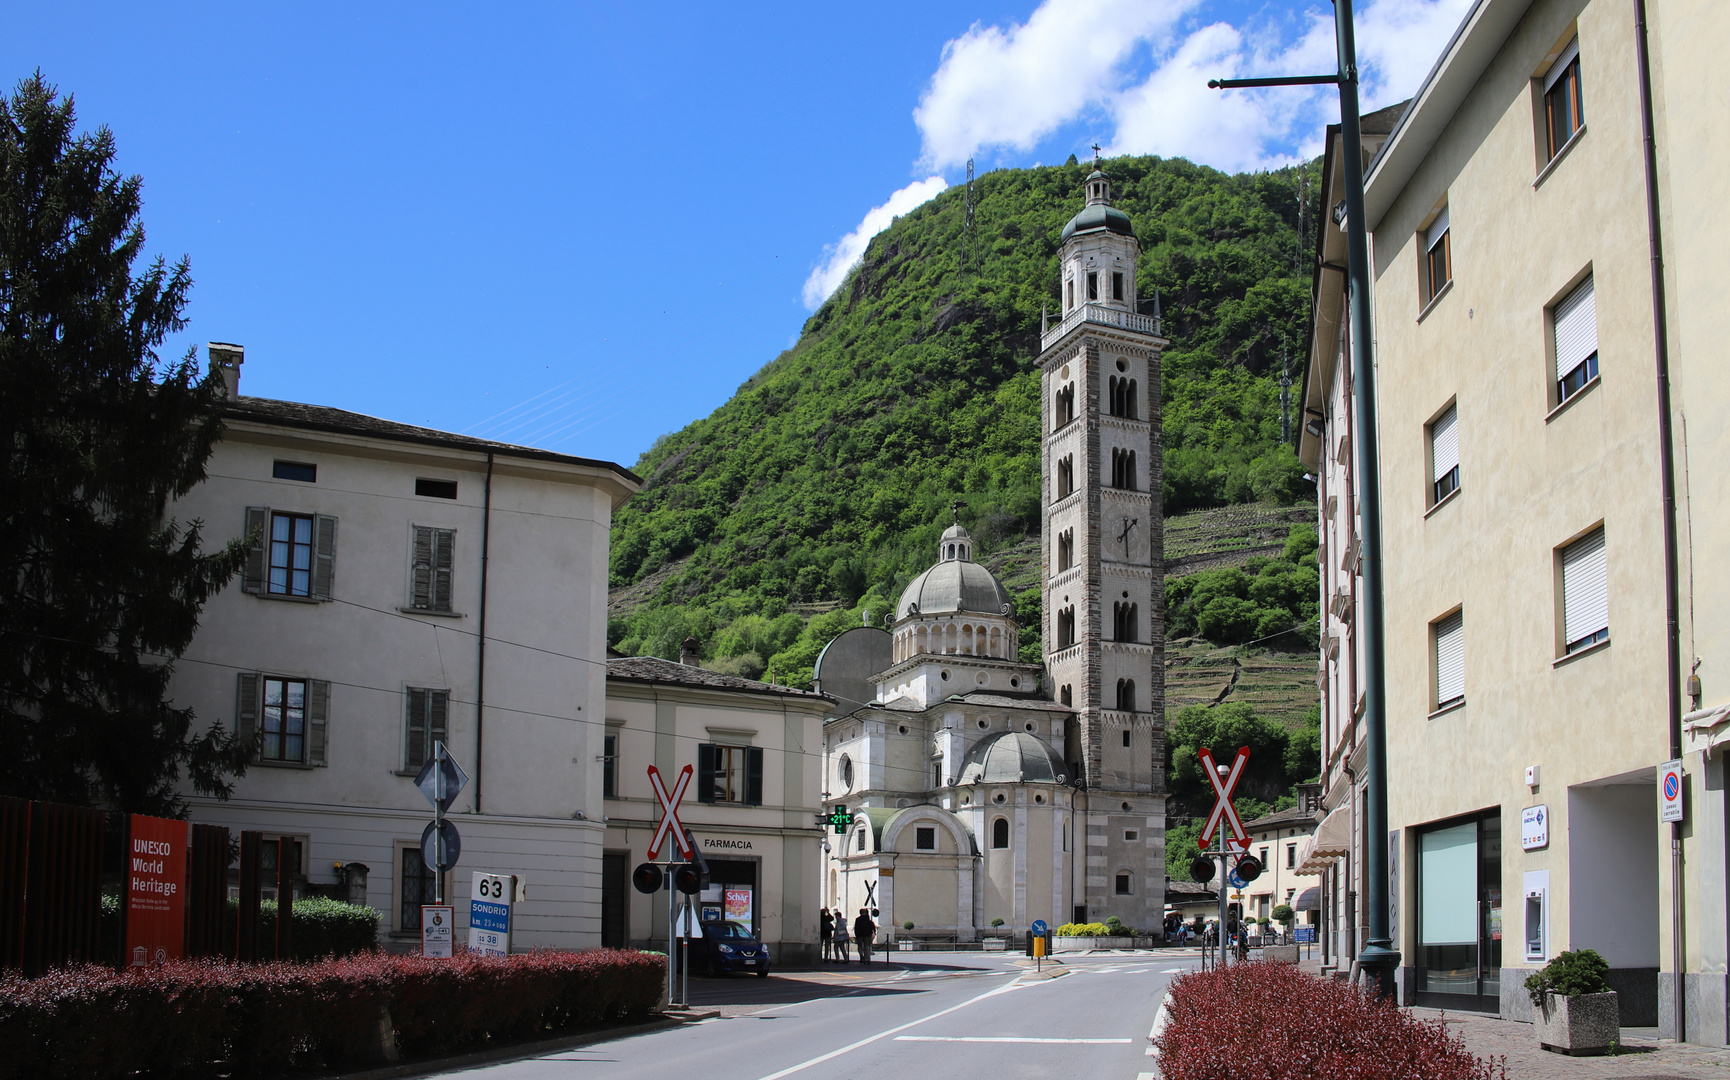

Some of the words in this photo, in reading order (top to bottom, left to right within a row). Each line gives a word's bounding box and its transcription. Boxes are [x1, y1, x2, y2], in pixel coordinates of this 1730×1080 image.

[134, 839, 170, 855] UNESCO
[704, 839, 753, 849] FARMACIA
[133, 858, 163, 874] World
[132, 877, 177, 896] Heritage
[480, 878, 502, 898] 63
[472, 903, 507, 916] SONDRIO
[486, 935, 497, 944] 38
